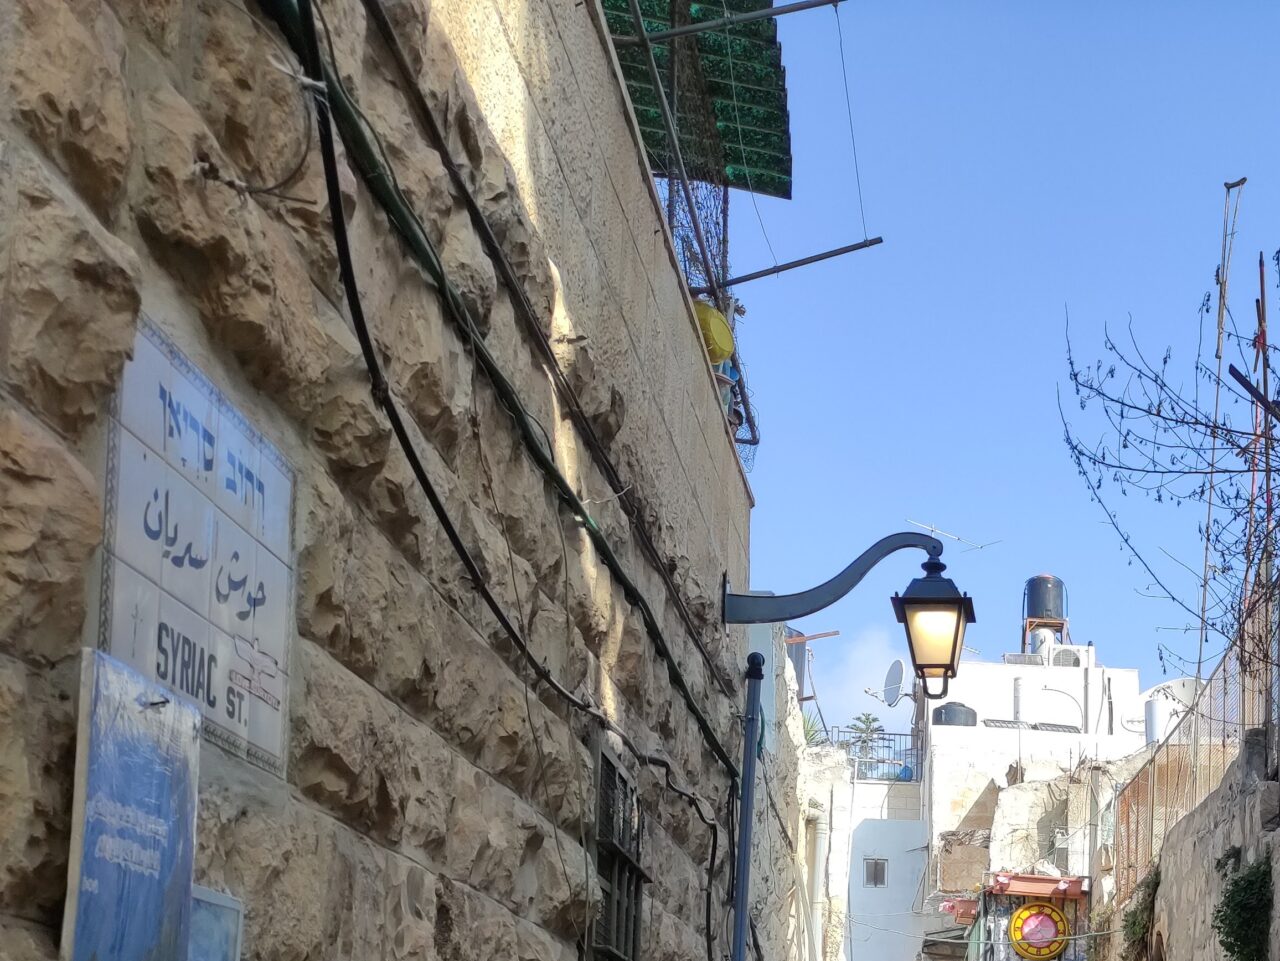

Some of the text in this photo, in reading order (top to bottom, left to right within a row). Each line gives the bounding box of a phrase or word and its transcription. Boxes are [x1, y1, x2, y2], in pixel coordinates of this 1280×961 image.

[215, 550, 266, 621] حوش
[156, 622, 218, 709] SYRIAC
[226, 686, 248, 728] ST.
